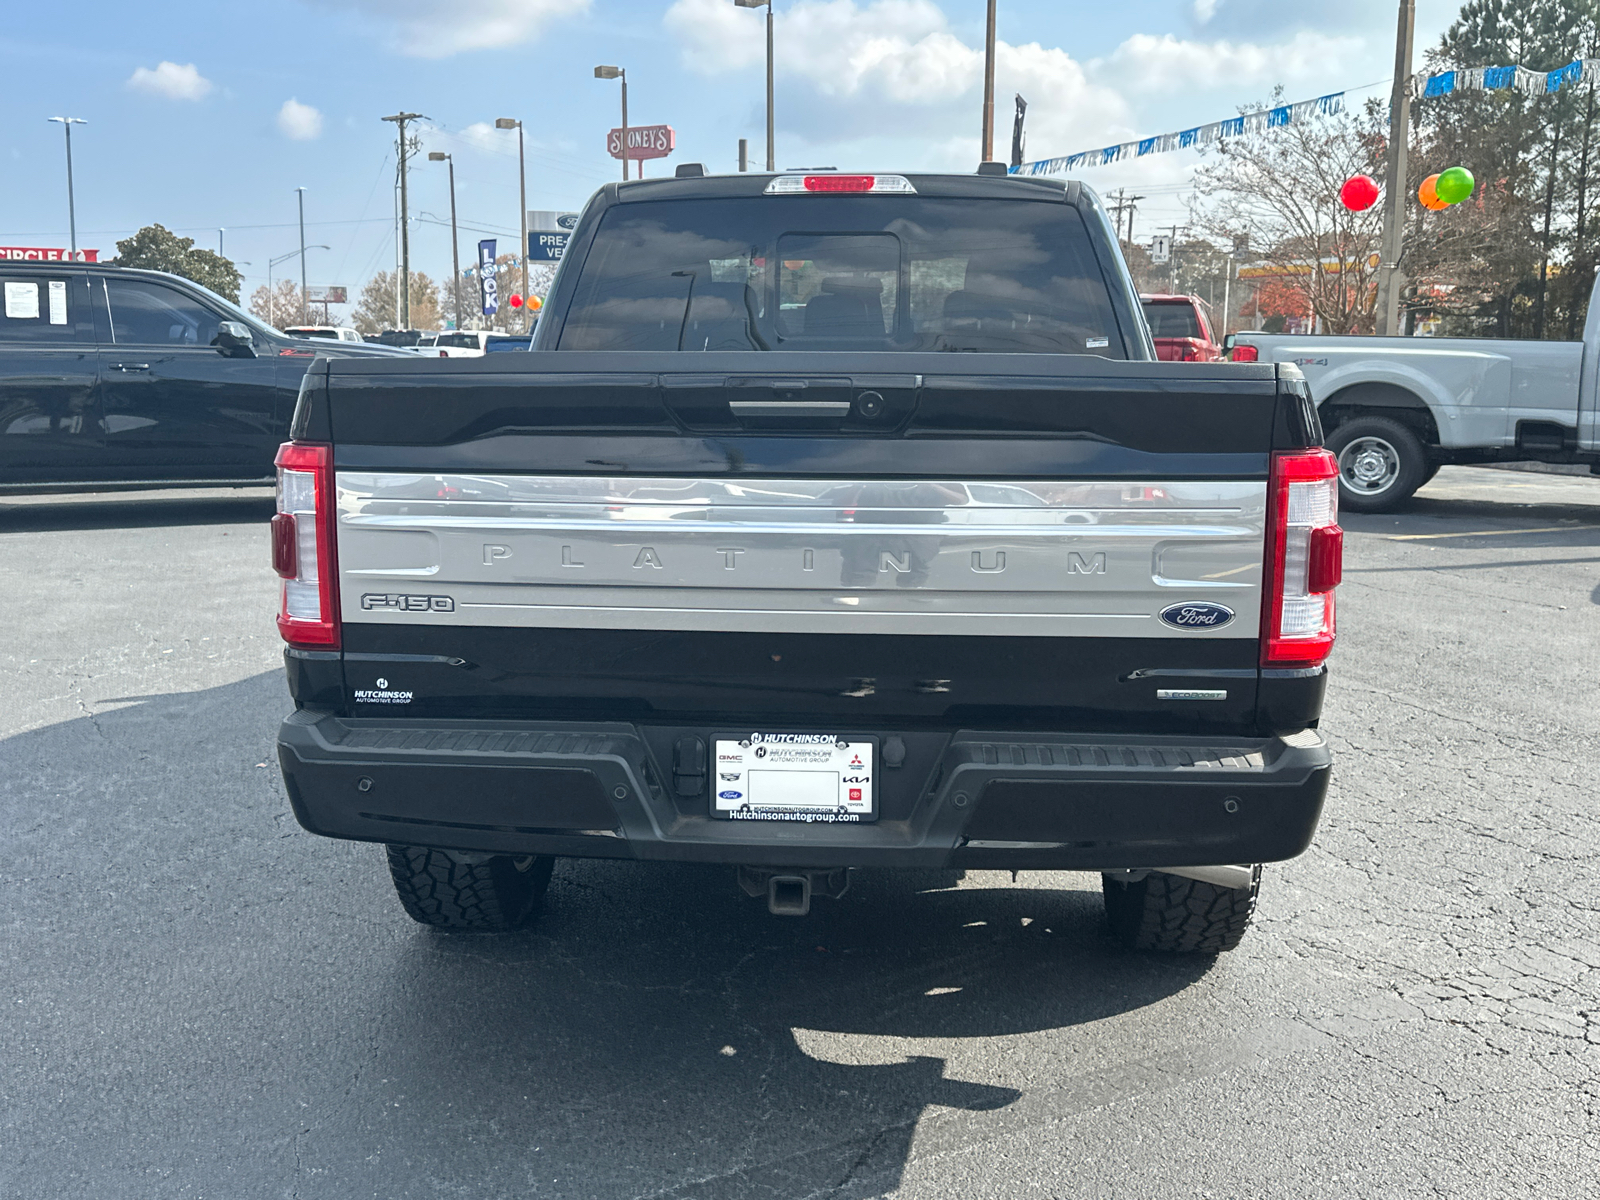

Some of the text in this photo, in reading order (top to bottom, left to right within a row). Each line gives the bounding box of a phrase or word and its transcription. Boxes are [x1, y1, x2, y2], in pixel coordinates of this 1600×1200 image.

[539, 235, 570, 246] PRE-
[546, 247, 565, 258] VE
[483, 543, 1107, 575] PLATINUM
[360, 593, 455, 613] F-150
[1177, 607, 1218, 624] Ford
[354, 690, 413, 699] HUTCHINSON
[764, 733, 837, 744] HUTCHINSON
[769, 749, 833, 757] HUTCHINSON
[729, 810, 859, 822] Hutchinsonautogroup.com
